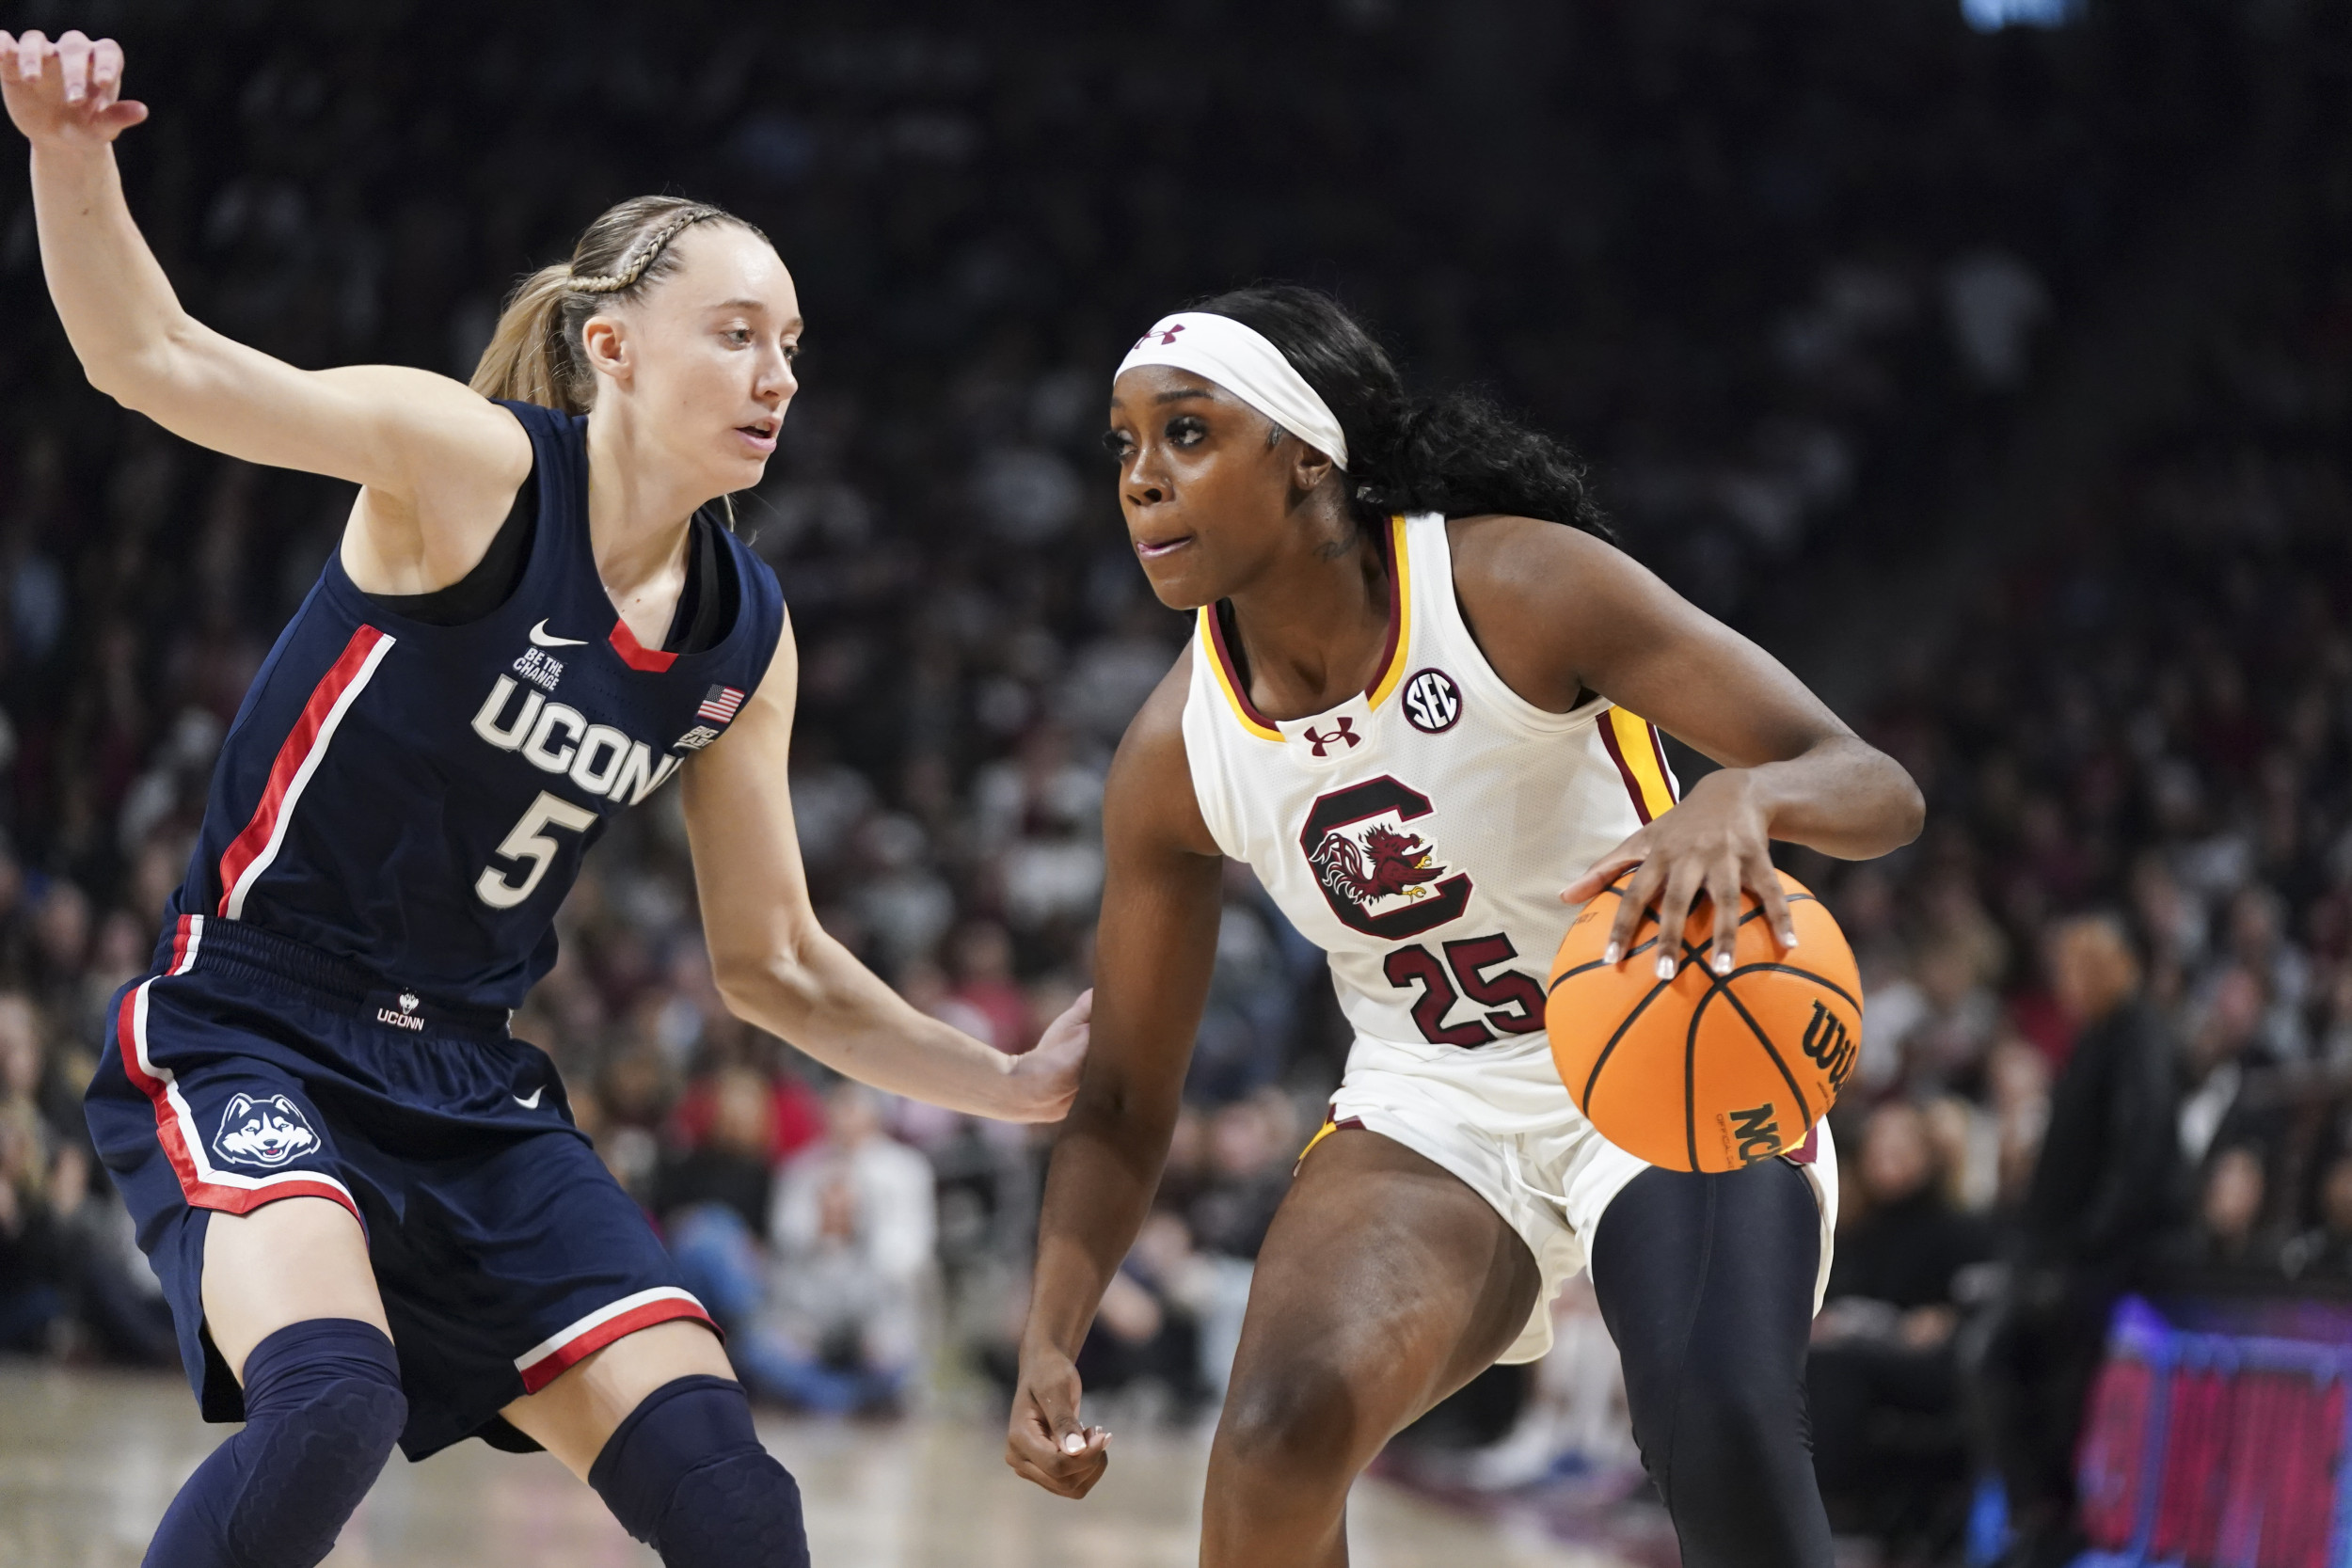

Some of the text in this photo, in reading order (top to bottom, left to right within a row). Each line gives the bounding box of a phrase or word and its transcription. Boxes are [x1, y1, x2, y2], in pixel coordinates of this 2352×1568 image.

[513, 657, 560, 691] CHANGE
[523, 647, 564, 677] BE THE
[1406, 672, 1458, 730] SEC
[470, 673, 686, 806] UCON
[475, 790, 599, 910] 5
[1299, 774, 1473, 941] C
[376, 1007, 425, 1032] UCONN
[1382, 932, 1547, 1048] 25
[1803, 999, 1856, 1093] Wil
